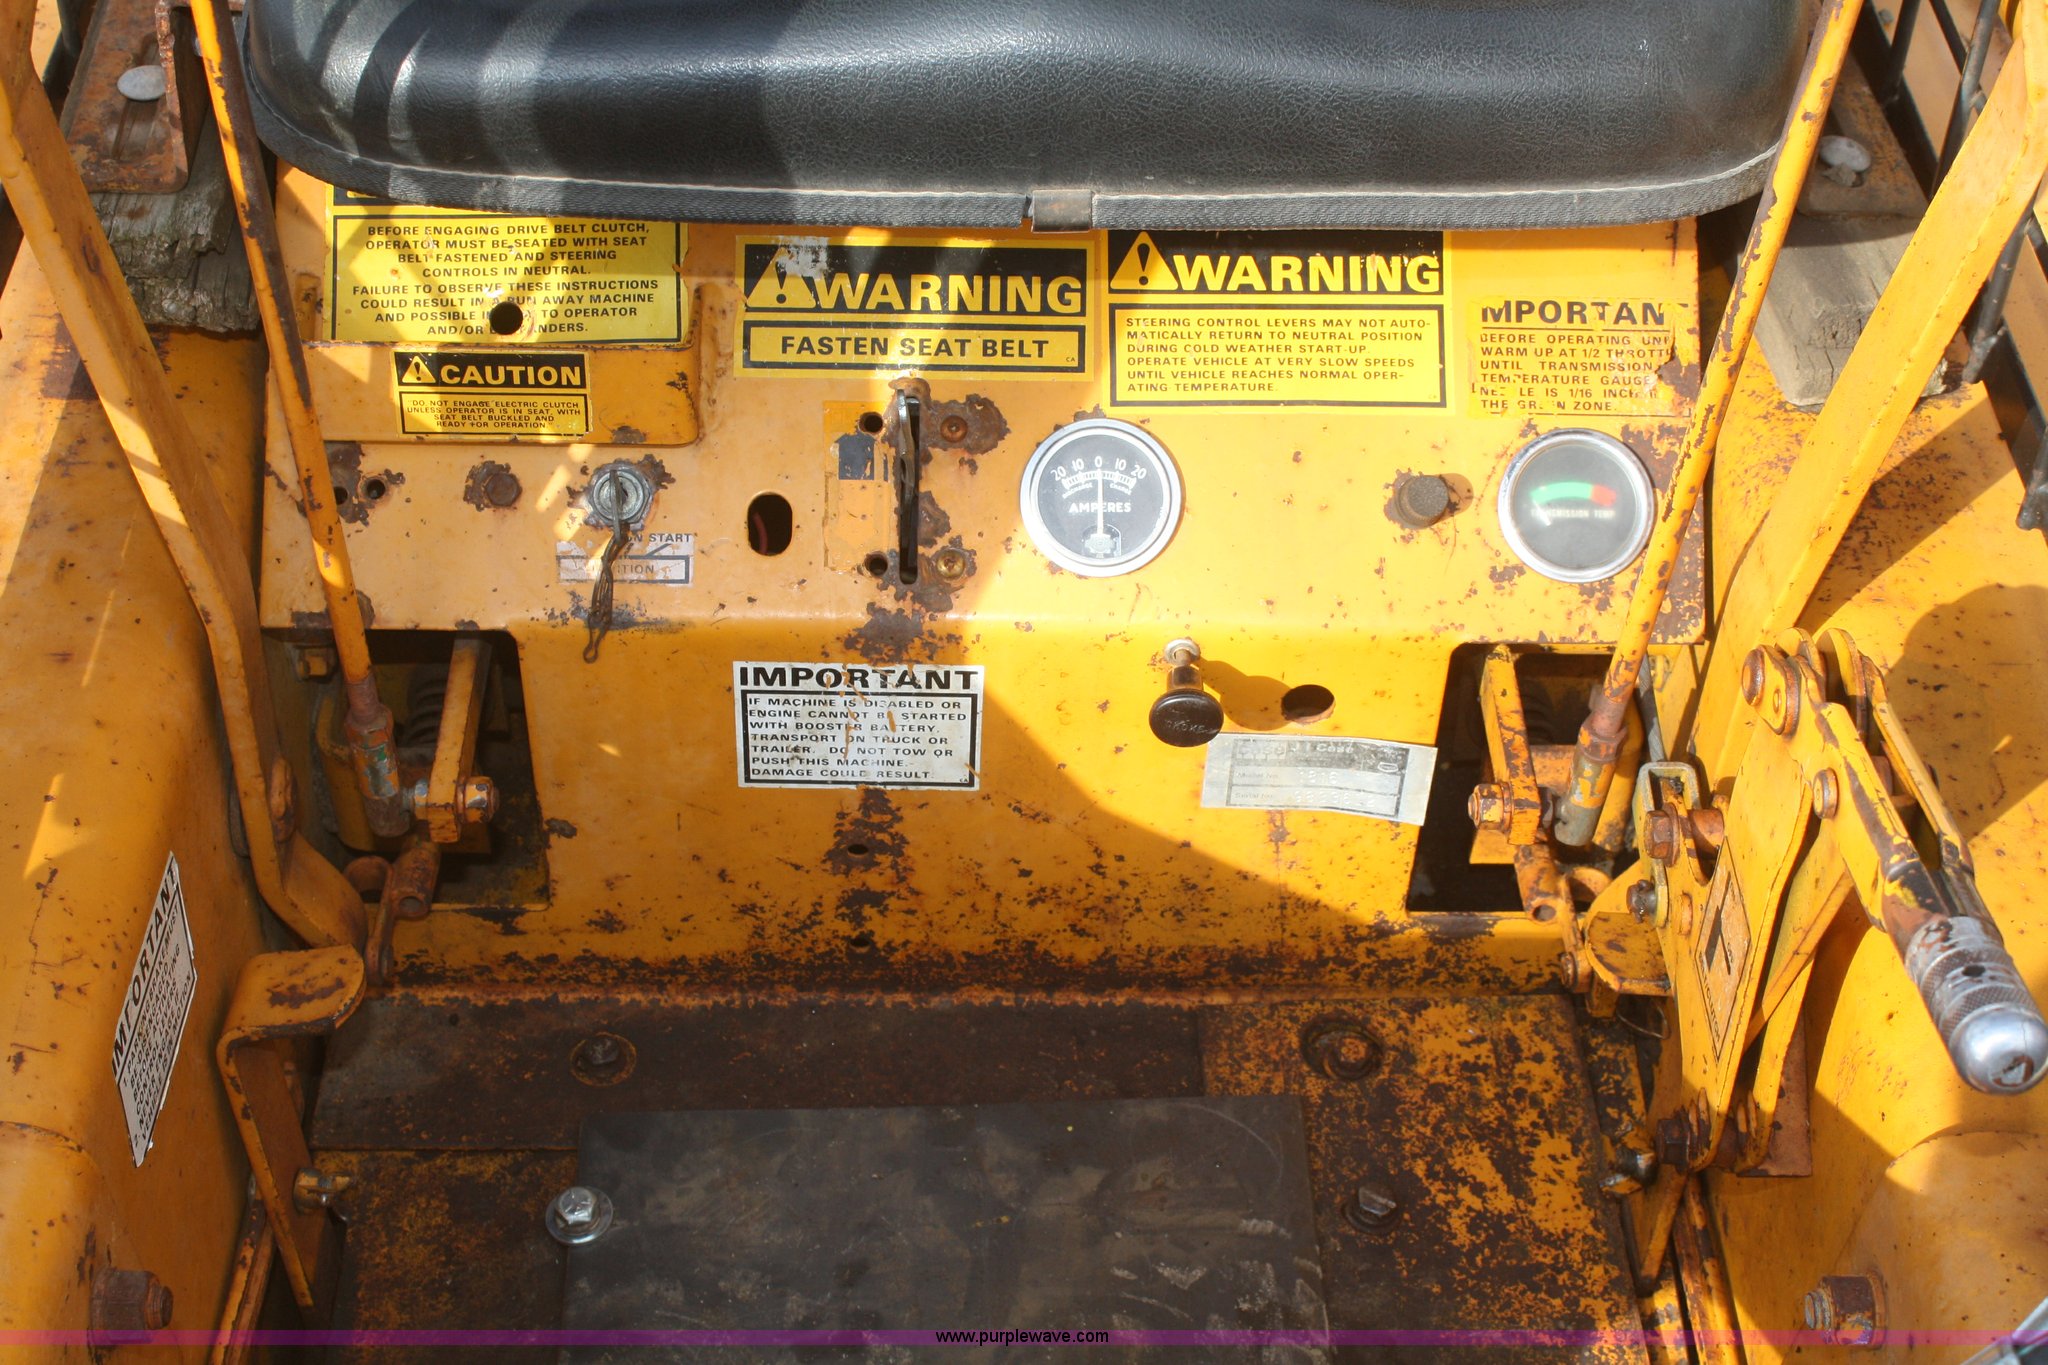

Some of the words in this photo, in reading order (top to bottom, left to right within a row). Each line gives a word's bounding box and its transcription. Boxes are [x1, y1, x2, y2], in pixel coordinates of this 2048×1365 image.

[368, 226, 419, 236] BEFORE
[425, 225, 499, 236] ENGAGING
[507, 225, 548, 235] DRIVE
[554, 224, 585, 234] BELT
[592, 223, 650, 234] CLUTCH,
[365, 239, 440, 250] OPERATOR
[446, 240, 485, 249] MUST
[492, 239, 508, 248] BE
[514, 237, 567, 247] SEATED
[573, 236, 607, 247] WITH
[613, 236, 647, 246] SEAT
[398, 253, 429, 263] BELT
[435, 252, 508, 263] FASTENED
[514, 252, 545, 261] AND
[551, 250, 617, 260] STEERING
[422, 267, 498, 277] CONTROLS
[504, 267, 517, 276] IN
[523, 265, 591, 275] NEUTRAL.
[1173, 255, 1439, 292] WARNING
[353, 285, 409, 295] FAILURE
[414, 284, 432, 294] TO
[508, 282, 551, 292] THESE
[557, 280, 658, 290] INSTRUCTIONS
[811, 272, 1081, 314] WARNING
[360, 298, 408, 309] COULD
[413, 297, 465, 308] RESULT
[471, 297, 484, 306] IN
[542, 295, 584, 305] AWAY
[590, 293, 654, 303] MACHINE
[375, 311, 405, 322] AND
[410, 310, 476, 321] POSSIBLE
[542, 309, 559, 318] TO
[564, 308, 637, 317] OPERATOR
[1126, 318, 1191, 327] STEERING
[1197, 318, 1261, 327] CONTROL
[1267, 319, 1316, 328] LEVERS
[1323, 319, 1352, 328] MAY
[1359, 319, 1385, 328] NOT
[1390, 319, 1431, 328] AUTO-
[427, 324, 484, 334] AND/OR
[1127, 331, 1202, 340] MATICALLY
[1209, 331, 1263, 340] RETURN
[1269, 331, 1286, 340] TO
[1292, 332, 1355, 340] NEUTRAL
[1361, 332, 1422, 340] POSITION
[1481, 334, 1535, 343] BEFORE
[1547, 335, 1630, 345] OPERATING
[781, 336, 888, 356] FASTEN
[900, 338, 971, 357] SEAT
[982, 339, 1048, 358] BELT
[1127, 344, 1178, 352] DURING
[1184, 344, 1219, 352] COLD
[1226, 344, 1292, 353] WEATHER
[1481, 347, 1528, 357] WARM
[1534, 348, 1553, 357] UP
[1559, 348, 1576, 357] AT
[1582, 349, 1599, 358] 1/2
[1127, 357, 1187, 366] OPERATE
[1193, 357, 1248, 366] VEHICLE
[1255, 357, 1271, 366] AT
[1277, 357, 1312, 366] VERY
[1319, 358, 1358, 366] SLOW
[1364, 358, 1414, 367] SPEEDS
[1481, 361, 1522, 370] UNTIL
[1540, 361, 1652, 371] TRANSMISSION
[440, 364, 581, 385] CAUTION
[1127, 370, 1165, 379] UNTIL
[1171, 370, 1226, 379] VEHICLE
[1232, 370, 1293, 379] REACHES
[1300, 370, 1357, 379] NORMAL
[1364, 371, 1404, 380] OPER-
[1600, 376, 1650, 385] GAUGE
[1127, 383, 1167, 392] ATING
[1545, 388, 1558, 397] IS
[1569, 388, 1592, 398] 1/16
[1481, 399, 1508, 409] THE
[1574, 401, 1617, 411] ZONE.
[1072, 458, 1084, 472] 10
[1094, 456, 1103, 467] 0
[1115, 458, 1126, 471] 10
[1050, 466, 1066, 481] 20
[1131, 465, 1147, 479] 20
[1068, 502, 1131, 513] AMPERES
[649, 534, 691, 542] START
[740, 667, 978, 690] IMPORTANT
[748, 698, 761, 706] IF
[768, 698, 836, 707] MACHINE
[844, 699, 856, 707] IS
[864, 700, 934, 709] DISABLED
[941, 701, 961, 709] OR
[749, 710, 800, 718] ENGINE
[902, 713, 967, 721] STARTED
[749, 721, 787, 729] WITH
[751, 734, 836, 742] TRANSPORT
[928, 736, 948, 745] OR
[857, 747, 886, 755] NOT
[893, 748, 926, 756] TOW
[934, 748, 953, 757] OR
[752, 757, 790, 765] PUSH
[799, 758, 829, 766] THIS
[752, 768, 813, 776] DAMAGE
[149, 949, 164, 999] BRAKE
